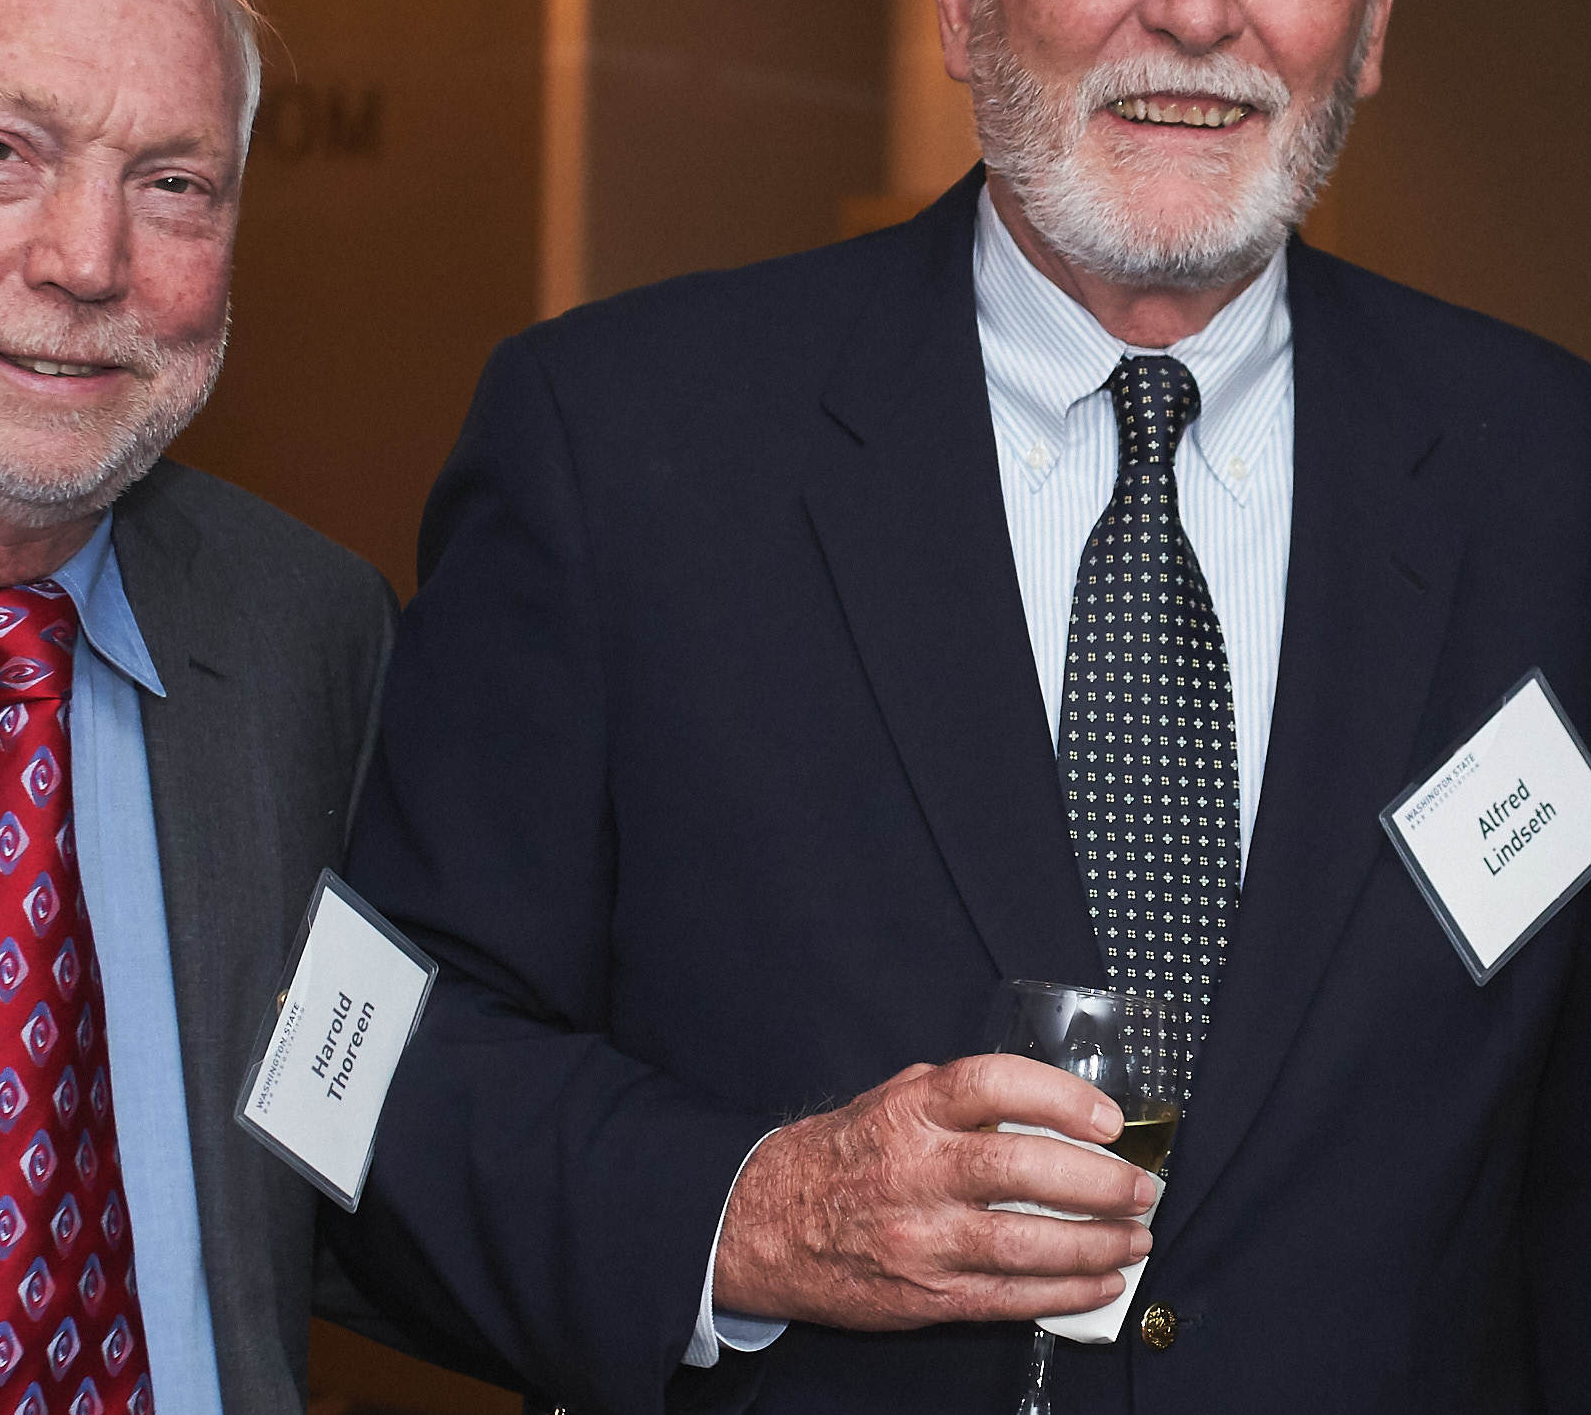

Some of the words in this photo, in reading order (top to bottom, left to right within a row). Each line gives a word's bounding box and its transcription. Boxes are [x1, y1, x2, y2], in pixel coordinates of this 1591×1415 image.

[1405, 774, 1453, 822] WASHINGTON
[1453, 753, 1475, 777] STATE
[1477, 778, 1531, 840] Alfred
[1483, 801, 1557, 876] Lindseth
[256, 1037, 288, 1109] WASHINGTON
[284, 1002, 300, 1036] STATE
[311, 991, 353, 1079] Harold
[327, 1001, 375, 1102] Thoreen
